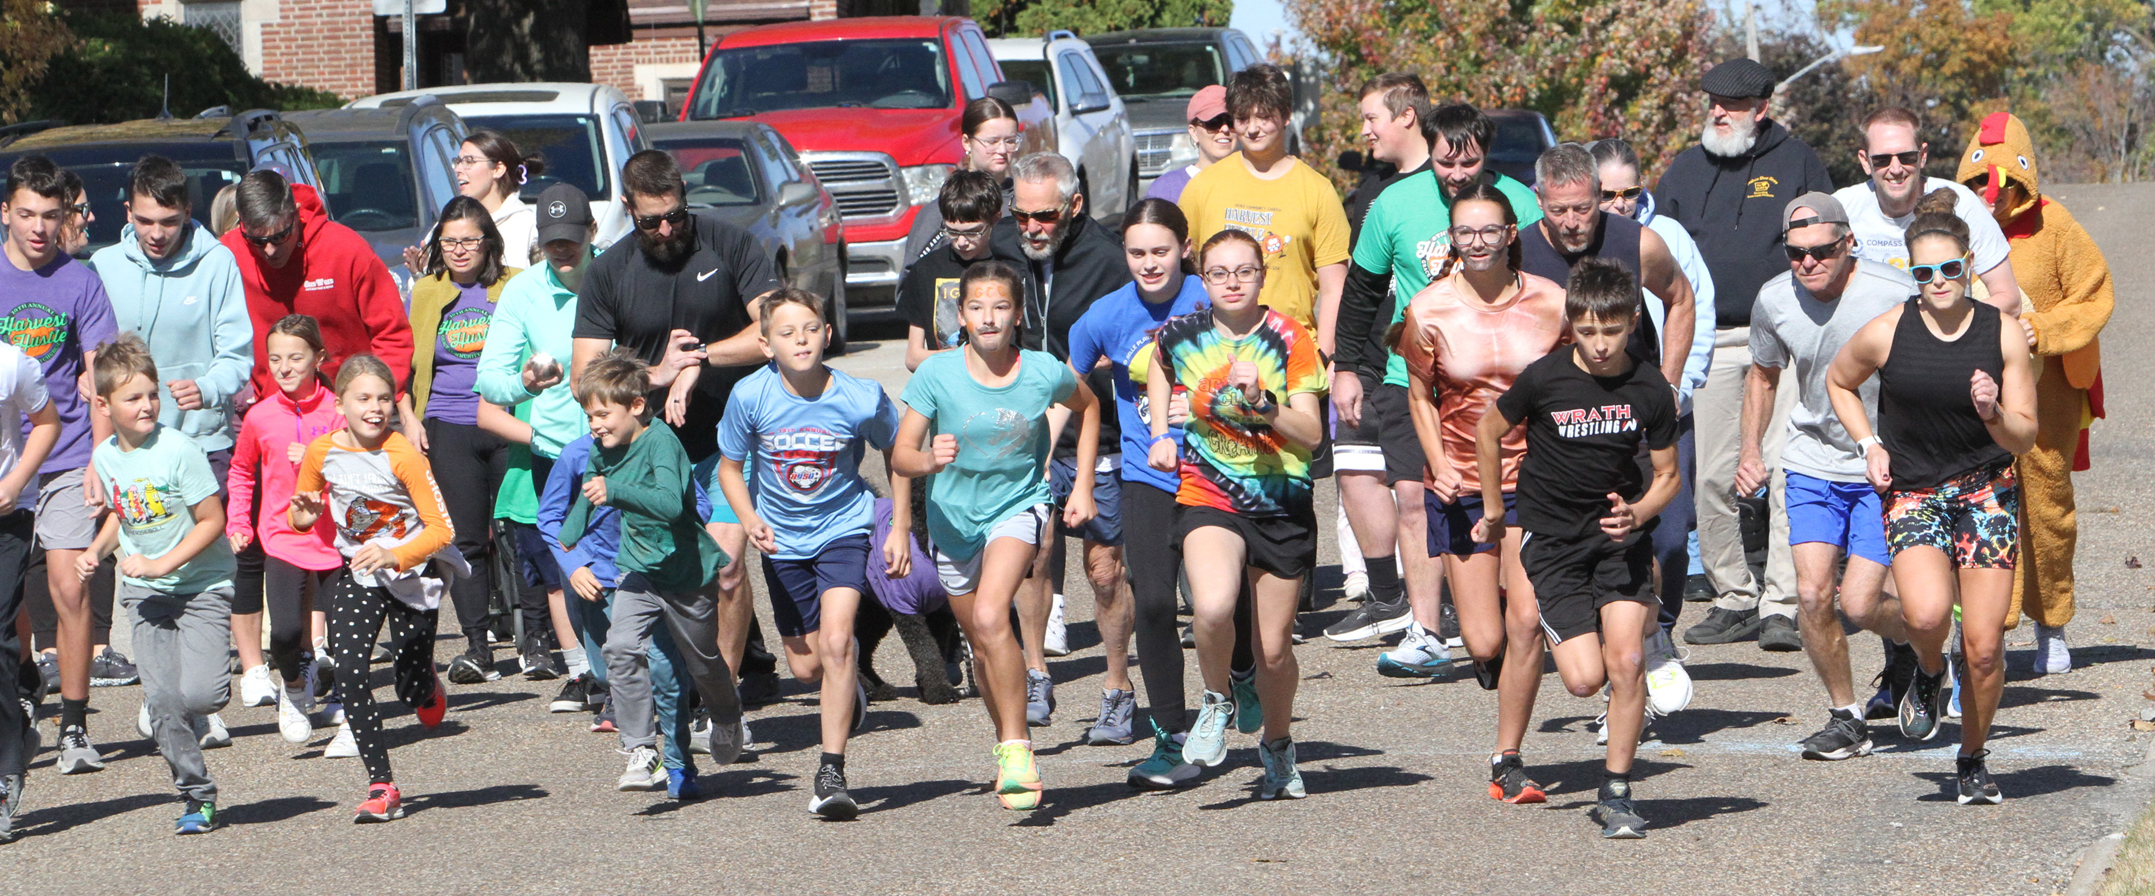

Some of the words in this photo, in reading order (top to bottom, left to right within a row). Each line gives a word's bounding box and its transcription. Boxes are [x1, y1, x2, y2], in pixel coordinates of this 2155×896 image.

[1225, 207, 1274, 226] HARVEST
[1866, 239, 1903, 247] COMPASS
[28, 303, 55, 315] ANNUAL
[0, 312, 68, 336] Harvest
[438, 315, 493, 336] Harves
[13, 329, 68, 352] Hustle
[450, 328, 489, 348] Hust
[1551, 404, 1632, 426] WRATH
[799, 427, 831, 436] ANNUAL
[1558, 420, 1620, 439] WRESTLING
[790, 472, 815, 480] AYSO
